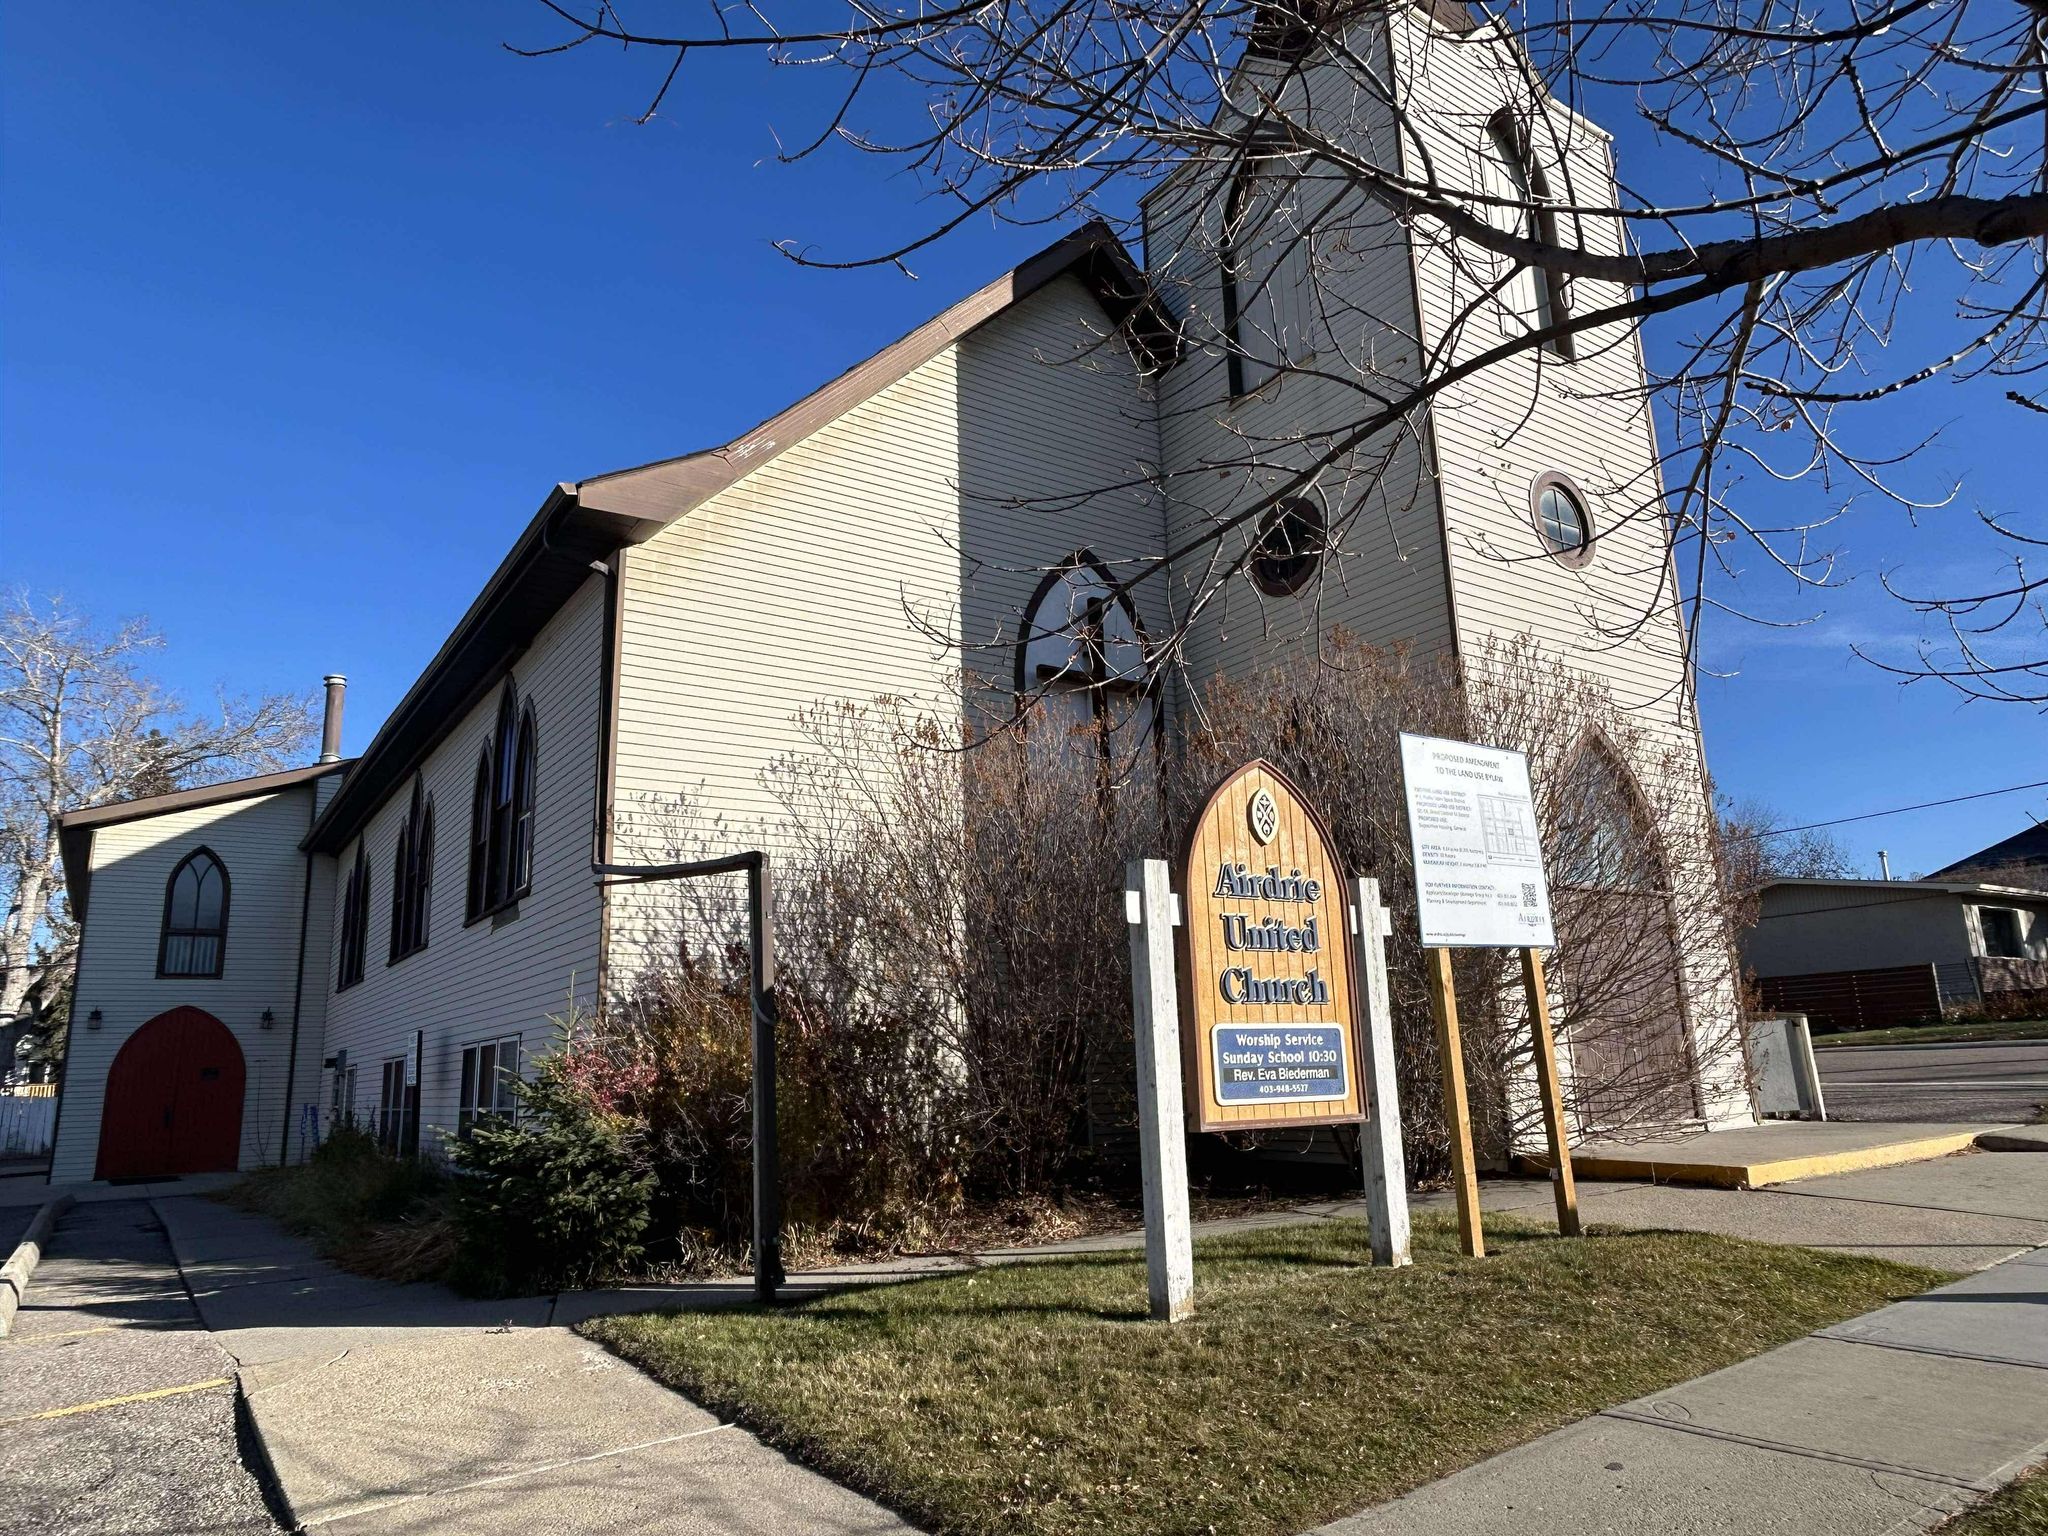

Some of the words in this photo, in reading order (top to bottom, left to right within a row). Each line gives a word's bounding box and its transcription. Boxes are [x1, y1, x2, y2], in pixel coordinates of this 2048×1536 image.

[1432, 752, 1464, 764] PROPOSED
[1465, 756, 1500, 769] AMENDMENT
[1435, 766, 1445, 775] TO
[1445, 767, 1457, 776] THE
[1458, 769, 1473, 778] LAND
[1474, 771, 1485, 780] USE
[1485, 773, 1504, 783] BYLAW
[1213, 861, 1321, 903] Airdrie
[1219, 912, 1321, 954] United
[1220, 966, 1329, 1005] Church
[1236, 1034, 1281, 1049] Worship
[1285, 1033, 1324, 1046] Service
[1222, 1051, 1264, 1066] Sunday
[1268, 1050, 1304, 1063] School
[1308, 1050, 1337, 1062] 10:30
[1233, 1068, 1256, 1081] Rev.
[1258, 1068, 1277, 1080] Eva
[1279, 1065, 1330, 1080] Biederman
